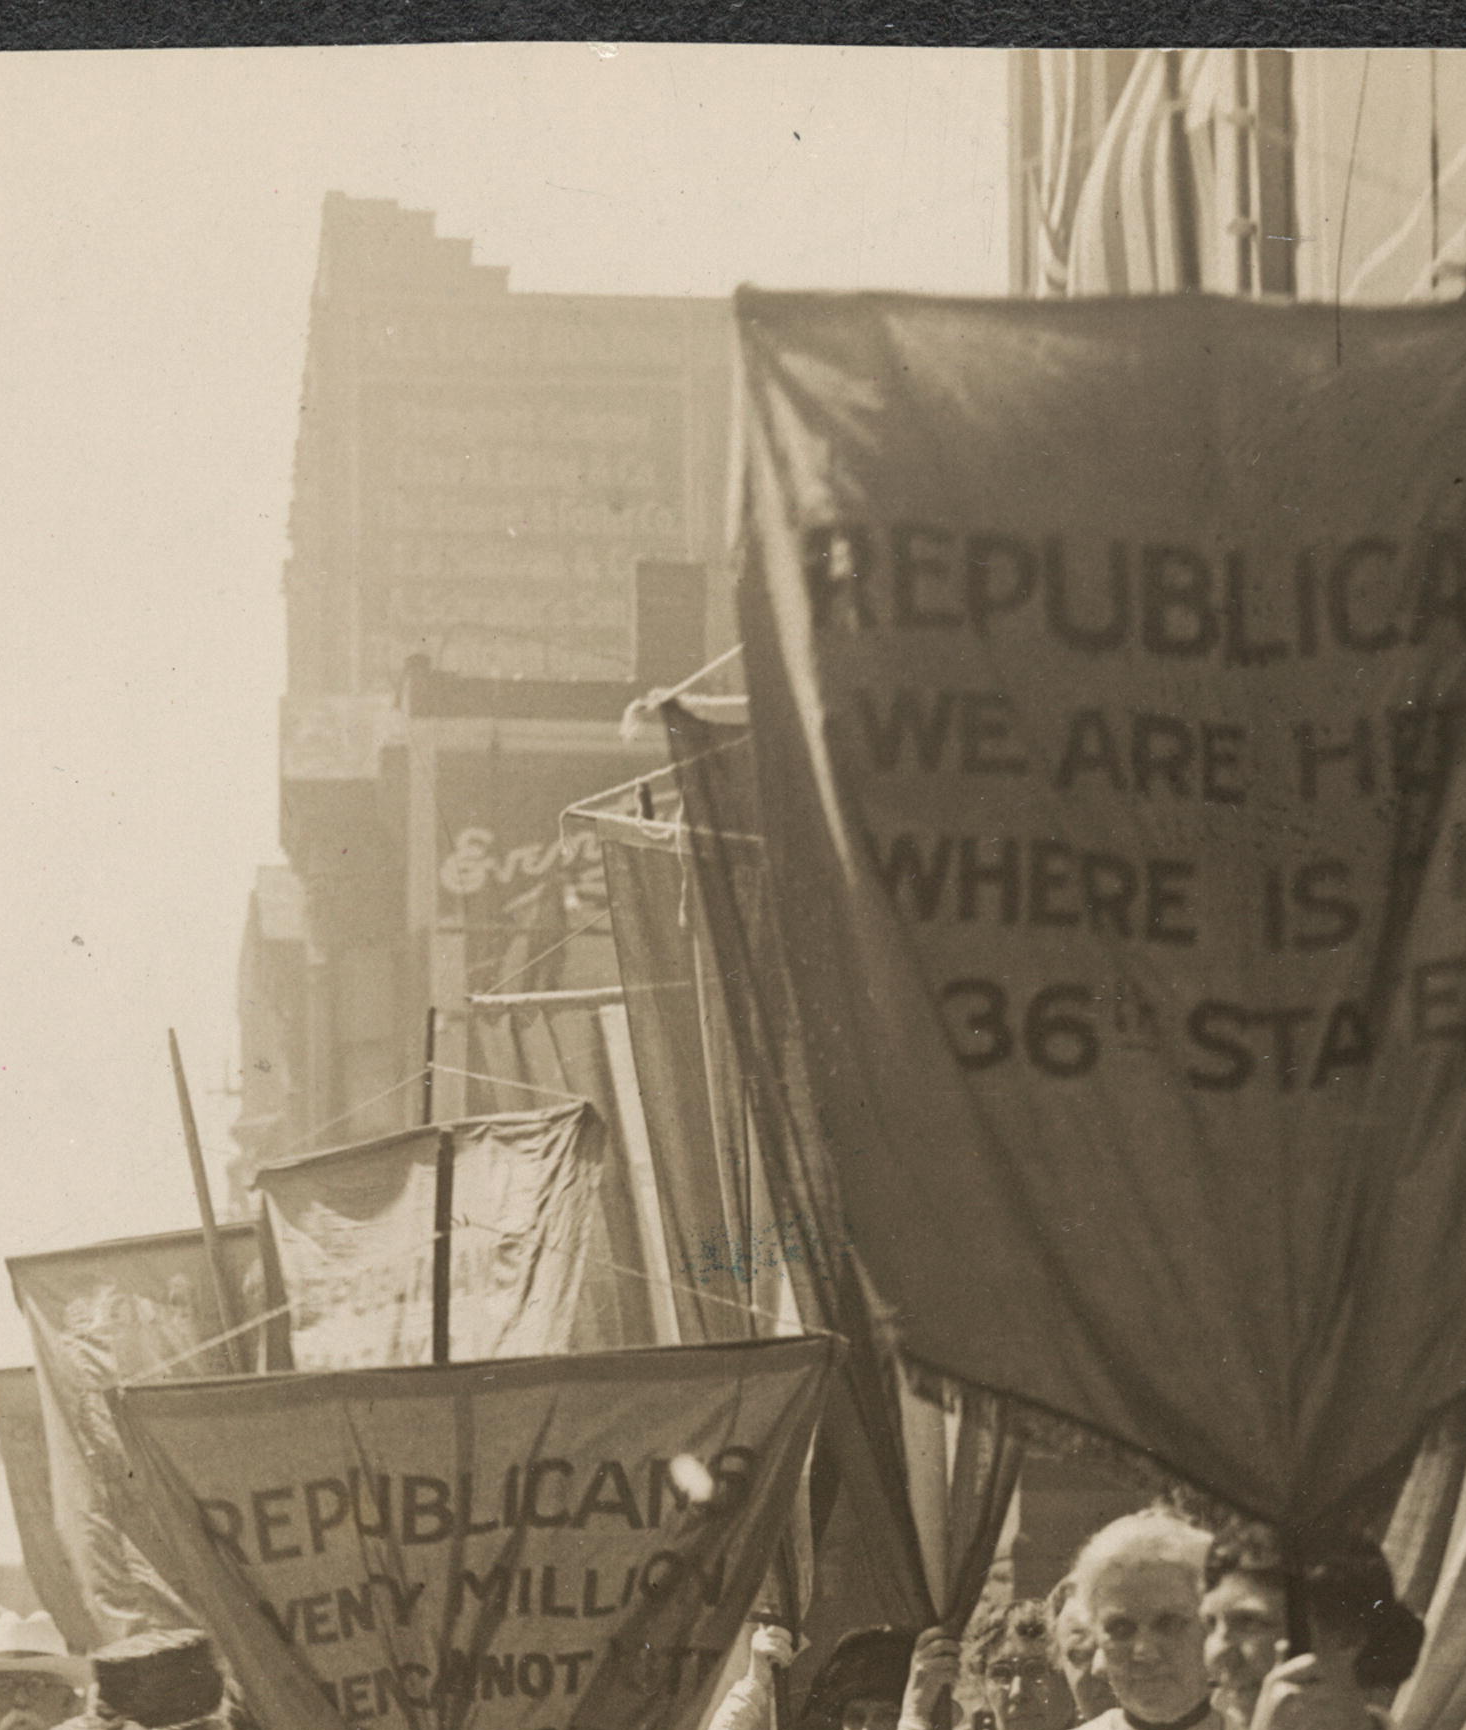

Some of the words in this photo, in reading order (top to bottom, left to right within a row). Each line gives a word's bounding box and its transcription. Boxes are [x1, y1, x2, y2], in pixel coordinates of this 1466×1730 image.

[853, 687, 1027, 776] WE
[1051, 706, 1247, 804] ARE
[866, 829, 1199, 949] WHERE
[1263, 858, 1361, 951] IS
